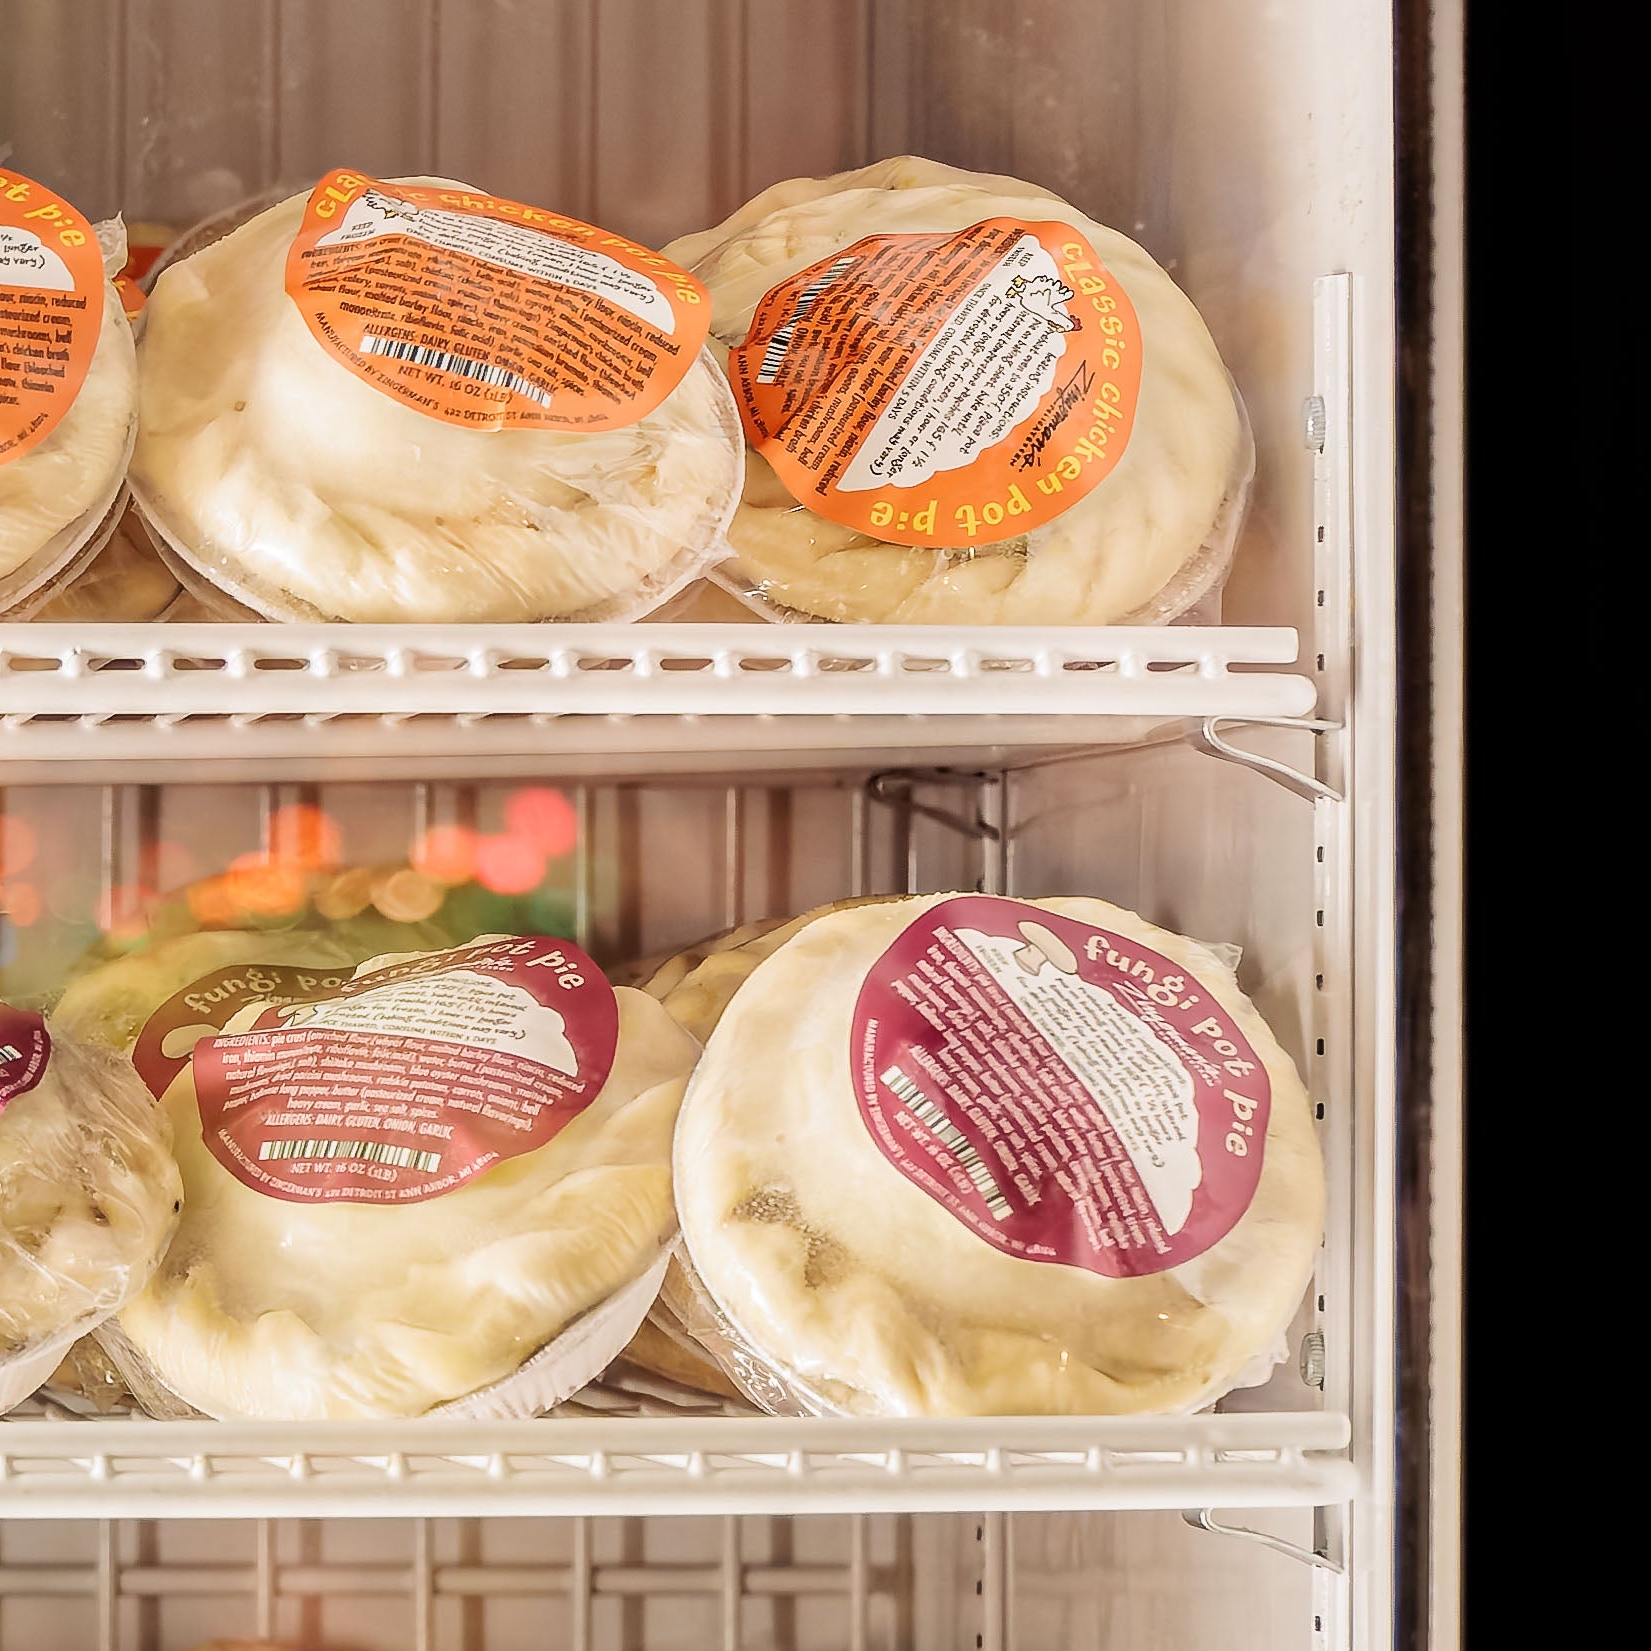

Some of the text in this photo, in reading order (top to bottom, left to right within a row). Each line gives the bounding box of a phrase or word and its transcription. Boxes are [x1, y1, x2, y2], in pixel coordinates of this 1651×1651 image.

[23, 204, 88, 249] pie
[601, 237, 668, 270] pot
[664, 269, 701, 305] pie
[1037, 380, 1121, 495] chicken
[869, 500, 938, 535] pie
[955, 484, 1033, 536] pot
[184, 966, 282, 1016] fungi
[525, 948, 585, 991] pie
[1083, 934, 1259, 1158] fungi pot pie
